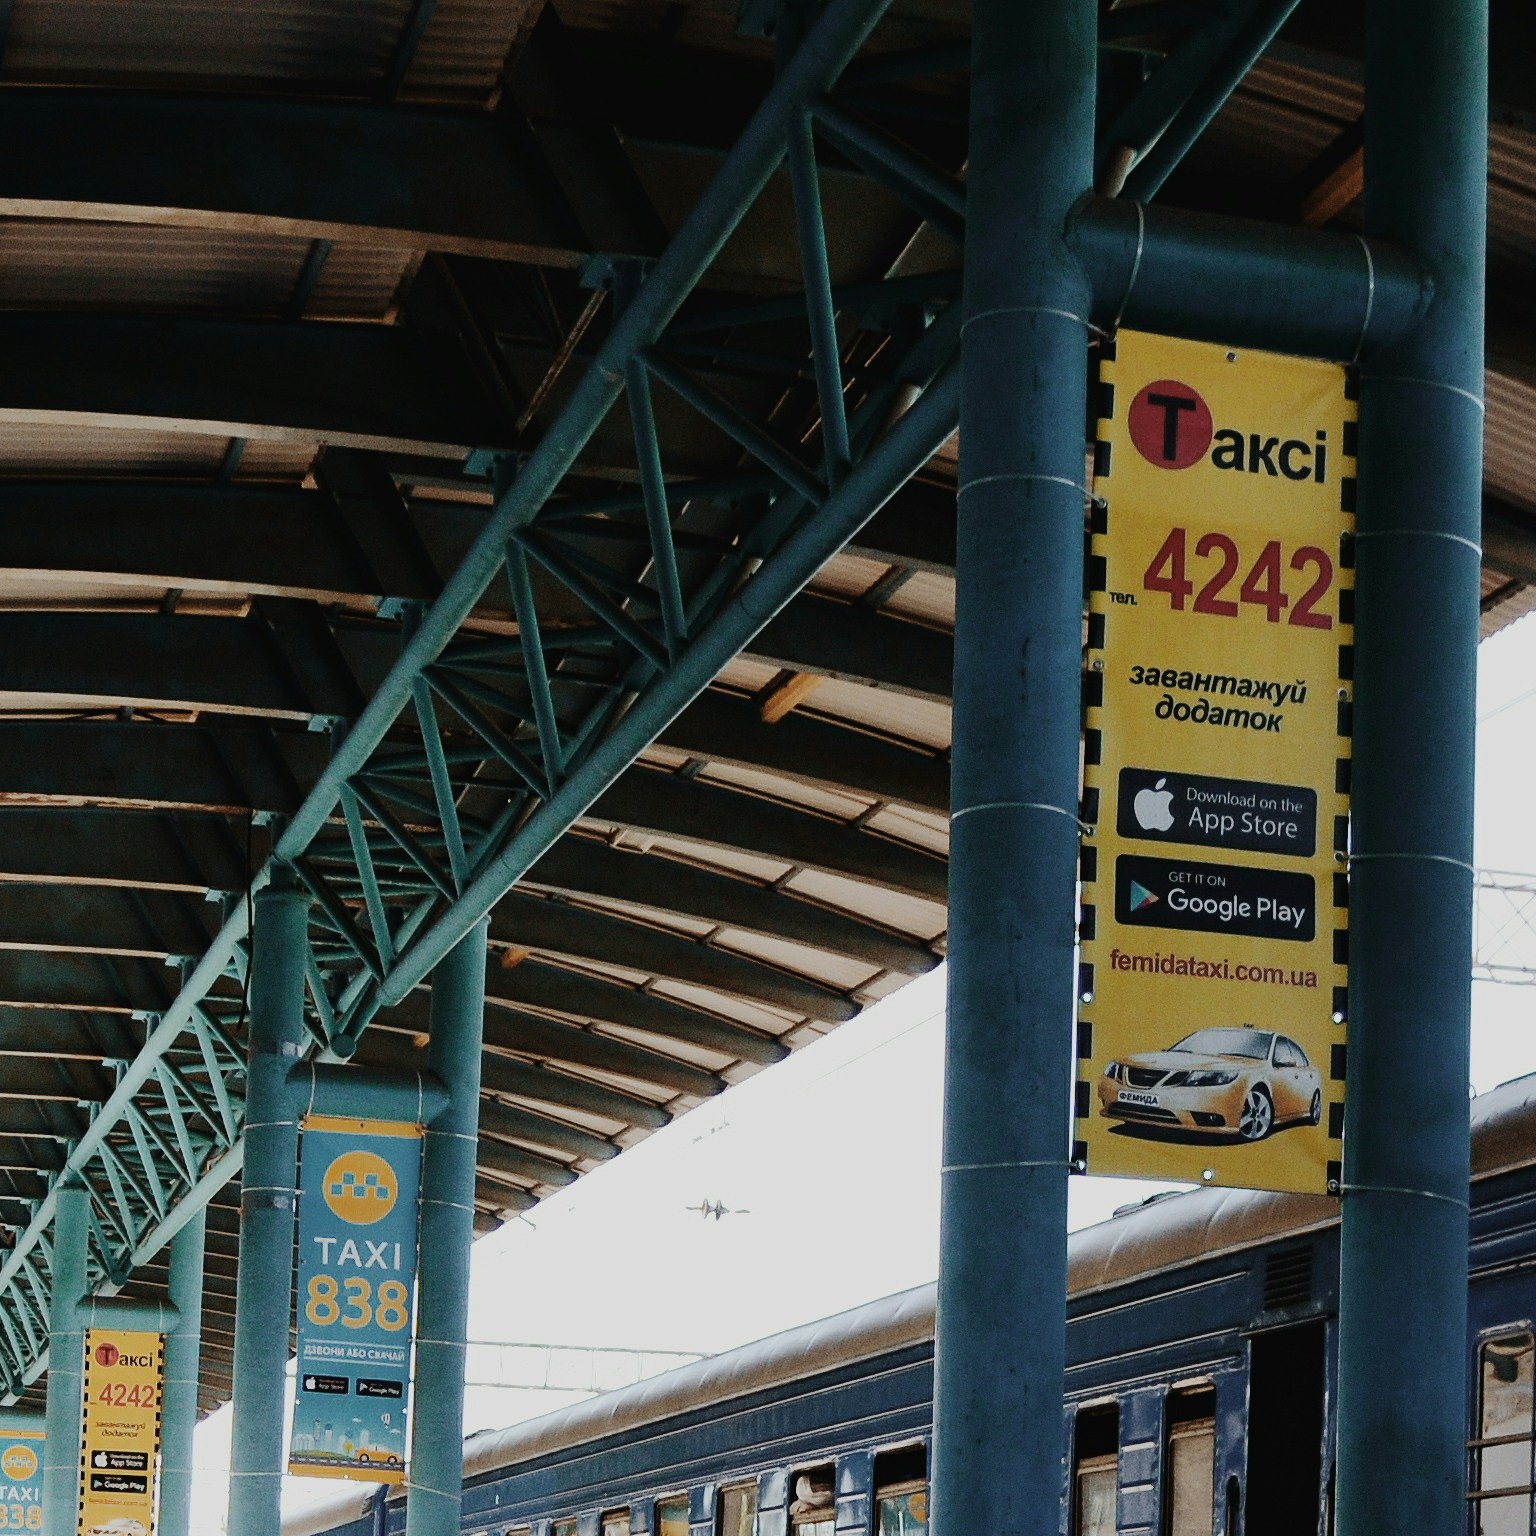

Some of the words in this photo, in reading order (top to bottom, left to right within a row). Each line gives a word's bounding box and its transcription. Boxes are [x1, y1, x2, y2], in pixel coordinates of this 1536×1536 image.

[1146, 391, 1327, 484] Таксі
[1109, 591, 1138, 606] тел.
[1143, 527, 1334, 631] 4242
[1128, 665, 1307, 708] завантажуй
[1154, 693, 1284, 733] додаток
[1186, 786, 1256, 809] Download
[1259, 797, 1280, 811] on
[1282, 798, 1303, 814] the
[1188, 807, 1235, 835] App
[1240, 812, 1299, 839] Store
[1168, 871, 1190, 884] GET
[1193, 873, 1205, 886] IT
[1207, 874, 1227, 888] ON
[1167, 887, 1252, 922] Google
[1257, 897, 1306, 929] Play
[1109, 948, 1319, 989] femidataxi.com.ua
[1119, 1091, 1159, 1106] ФЕМИДА
[313, 1236, 402, 1271] TAXI
[304, 1274, 409, 1332] 838
[98, 1346, 154, 1368] Таксі
[303, 1344, 345, 1357] ДЗВОНИ
[346, 1347, 367, 1359] АБО
[367, 1348, 406, 1362] СКАЧАЙ
[98, 1382, 155, 1409] 4242
